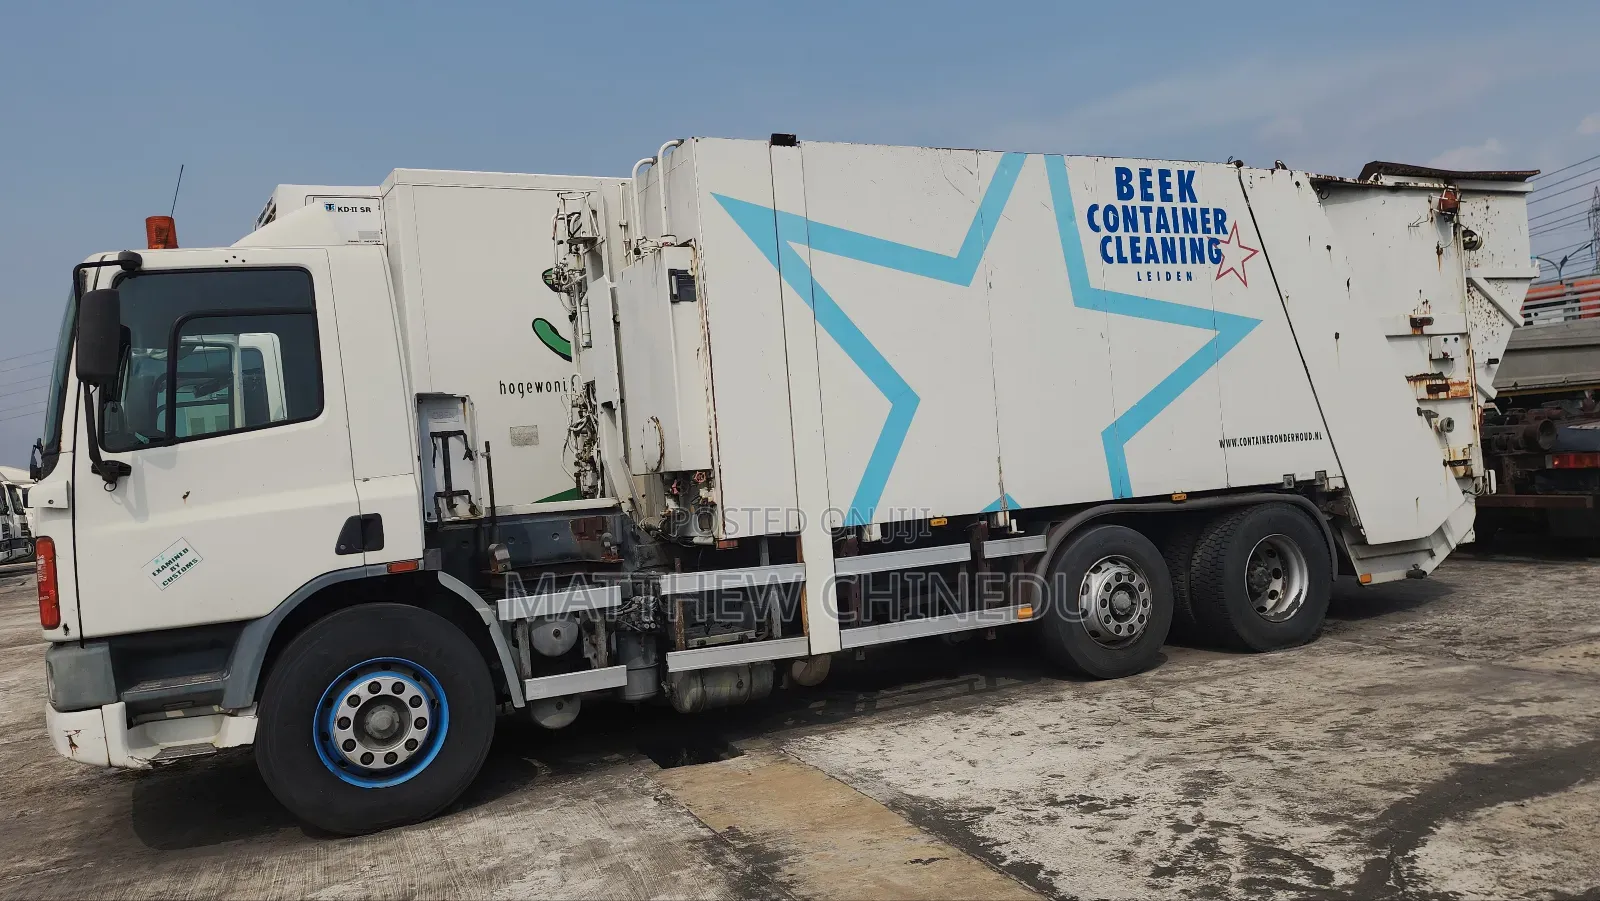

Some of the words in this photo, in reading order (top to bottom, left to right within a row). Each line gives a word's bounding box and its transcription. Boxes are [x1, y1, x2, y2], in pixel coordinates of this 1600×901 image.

[1114, 166, 1198, 203] BEEK
[1086, 203, 1228, 235] CONTAINER
[1099, 235, 1222, 265] CLEANING
[1137, 271, 1193, 282] LEIDEN
[499, 376, 575, 399] hogewoni
[1219, 431, 1323, 449] WWW.CONTAINERONDERHOUD.NL
[152, 547, 189, 577] EXAMINED
[162, 557, 199, 586] CUSTOMS
[169, 562, 181, 572] BY
